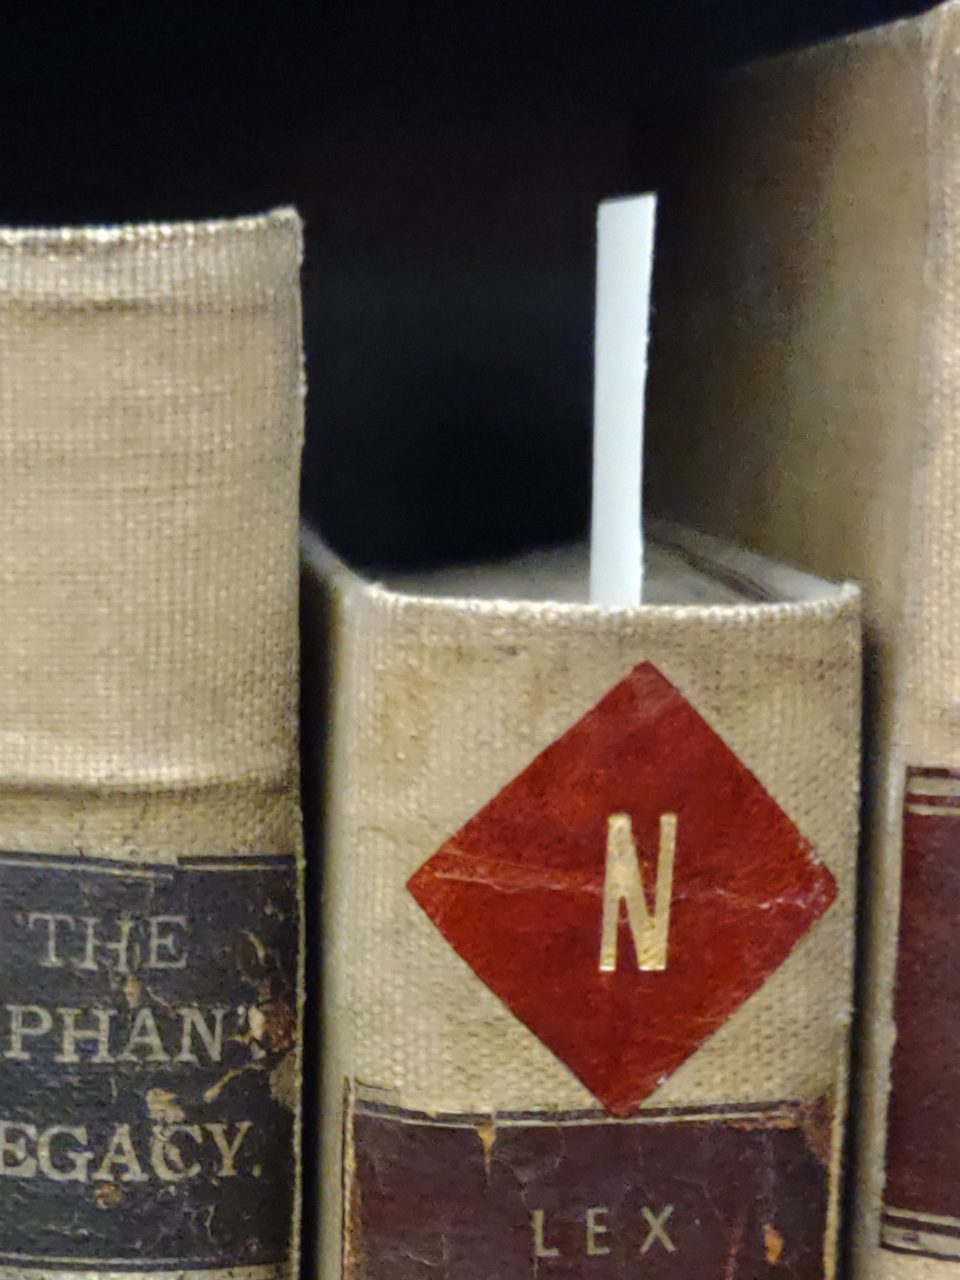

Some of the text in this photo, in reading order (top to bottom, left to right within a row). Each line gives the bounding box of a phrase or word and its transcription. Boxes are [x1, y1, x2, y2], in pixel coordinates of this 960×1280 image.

[599, 812, 677, 972] N
[27, 911, 189, 972] THE
[531, 1204, 677, 1258] LEX
